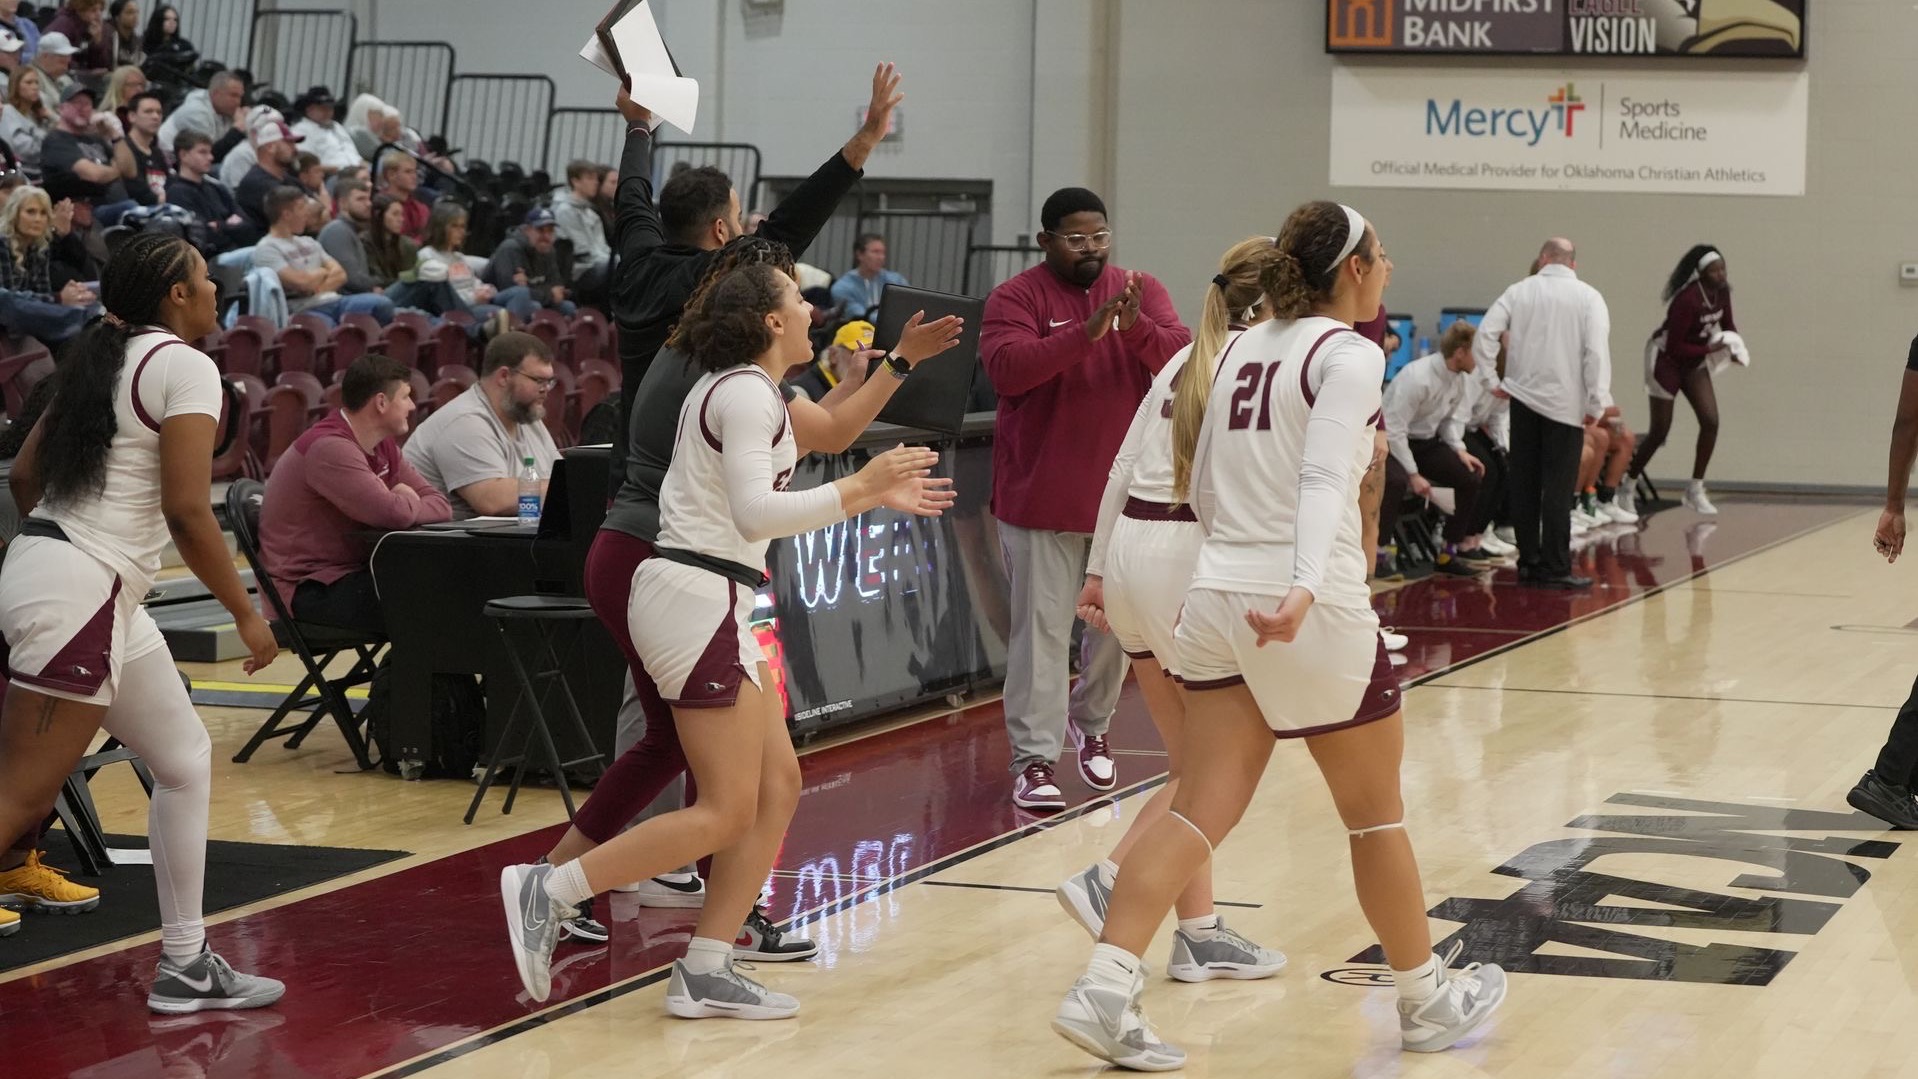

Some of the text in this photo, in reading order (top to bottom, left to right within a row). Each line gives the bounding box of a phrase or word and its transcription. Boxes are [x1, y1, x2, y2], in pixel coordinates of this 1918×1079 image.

[1403, 16, 1493, 47] BANK
[1569, 17, 1656, 53] VISION
[1425, 98, 1550, 147] Mercy
[1619, 97, 1680, 119] Sports
[1618, 121, 1708, 142] Medicine
[1371, 160, 1767, 183] Official Medical Provider for Oklahoma Christian Athletics
[1228, 360, 1282, 431] 21
